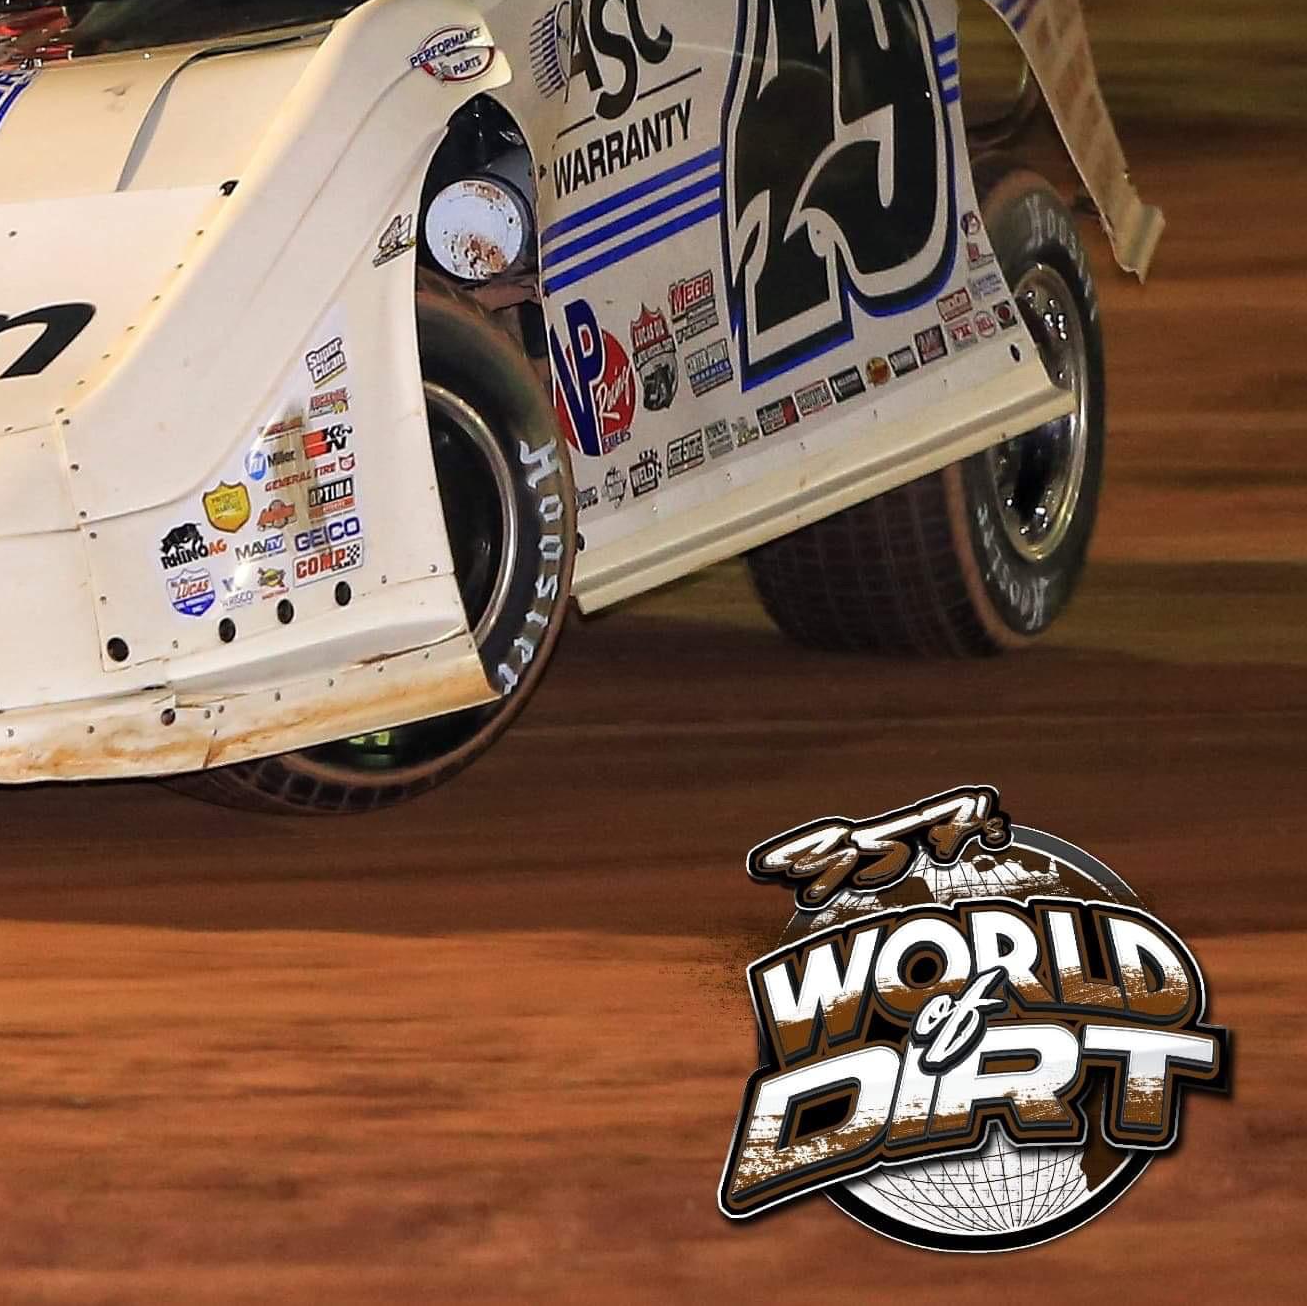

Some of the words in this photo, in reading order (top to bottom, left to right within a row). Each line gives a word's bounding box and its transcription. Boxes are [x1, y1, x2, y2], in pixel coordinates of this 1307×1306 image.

[451, 54, 483, 76] PARTS
[553, 97, 693, 200] WARRANTY
[308, 338, 342, 366] Super
[313, 353, 345, 382] Clean
[549, 298, 604, 457] VP
[596, 363, 634, 435] Racing
[267, 450, 296, 468] Miller
[265, 470, 312, 492] GENERAL
[314, 461, 337, 478] TIRE
[309, 480, 353, 506] OPTIMA
[295, 516, 361, 552] GEICO
[295, 547, 347, 579] COMP
